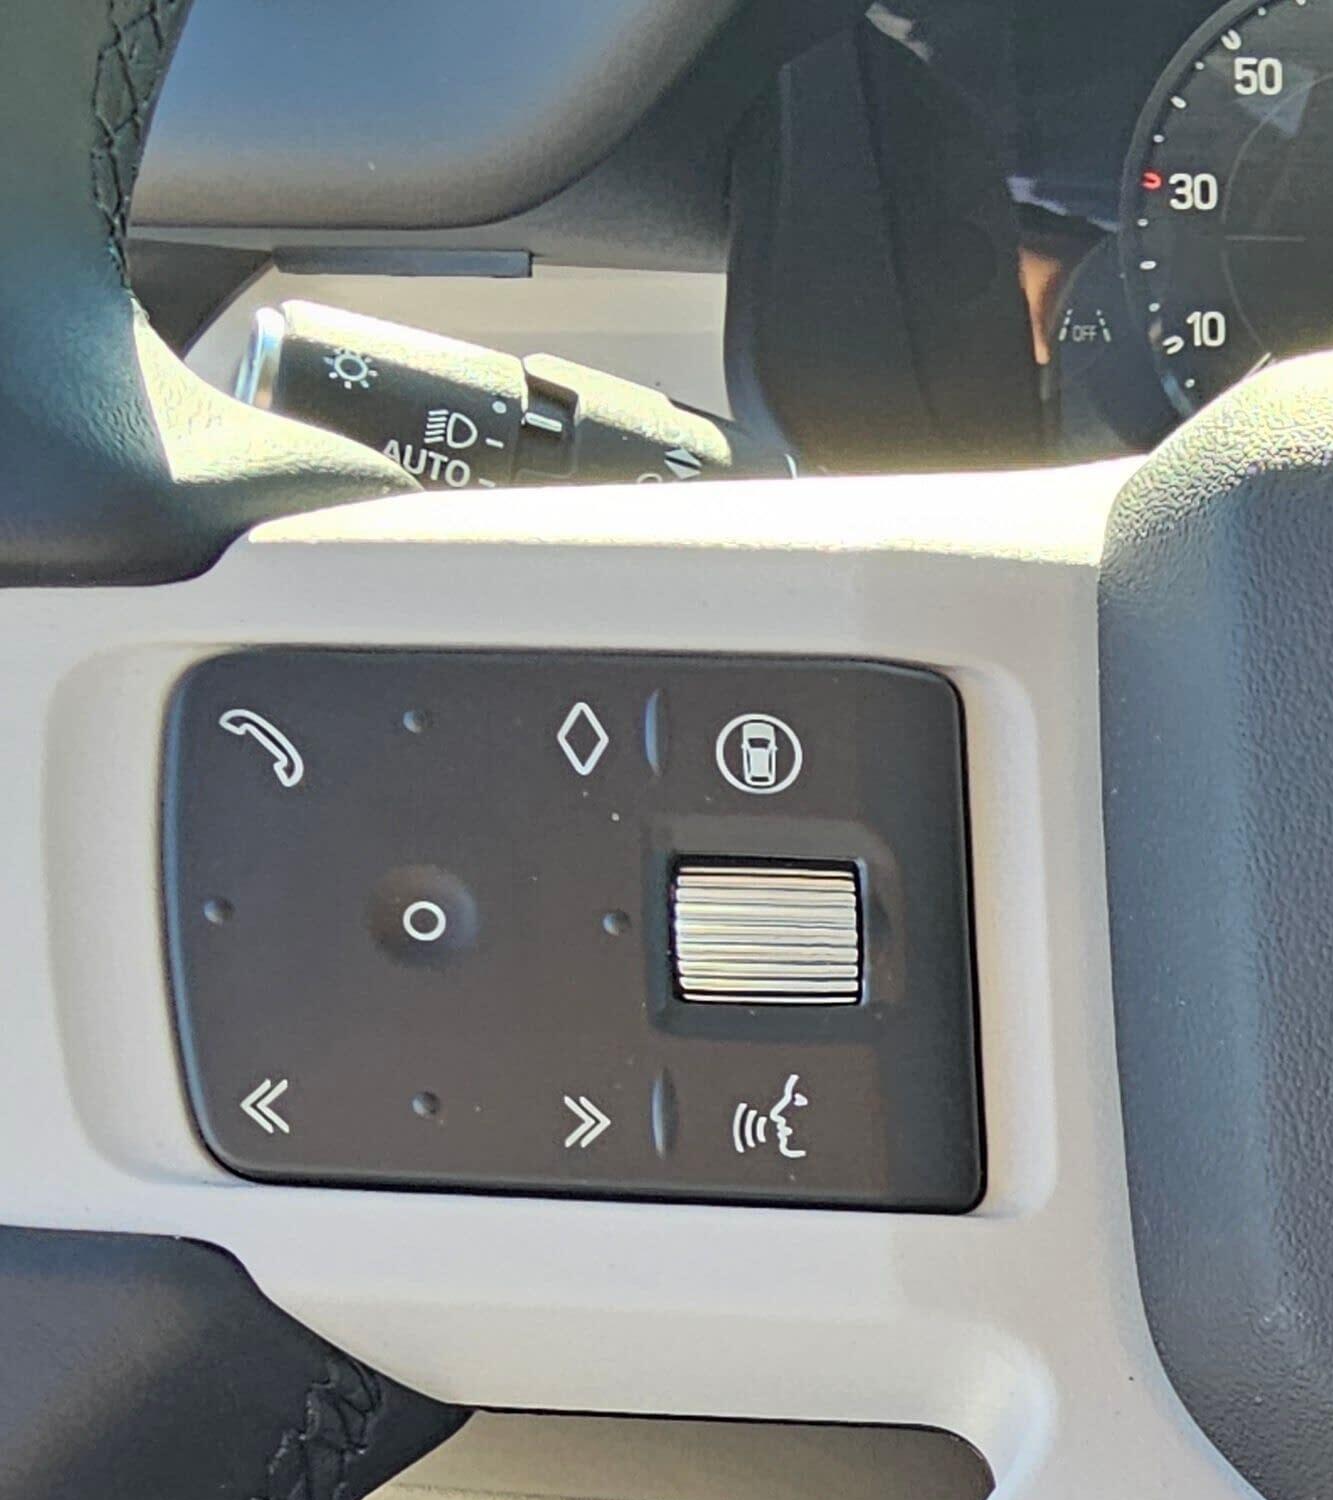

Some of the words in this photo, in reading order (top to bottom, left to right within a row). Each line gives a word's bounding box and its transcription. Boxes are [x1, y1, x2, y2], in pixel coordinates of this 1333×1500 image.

[1233, 56, 1283, 97] 50
[1168, 172, 1218, 211] 30
[1071, 324, 1098, 342] OFF
[1186, 310, 1226, 348] 10
[382, 438, 472, 489] AUTO
